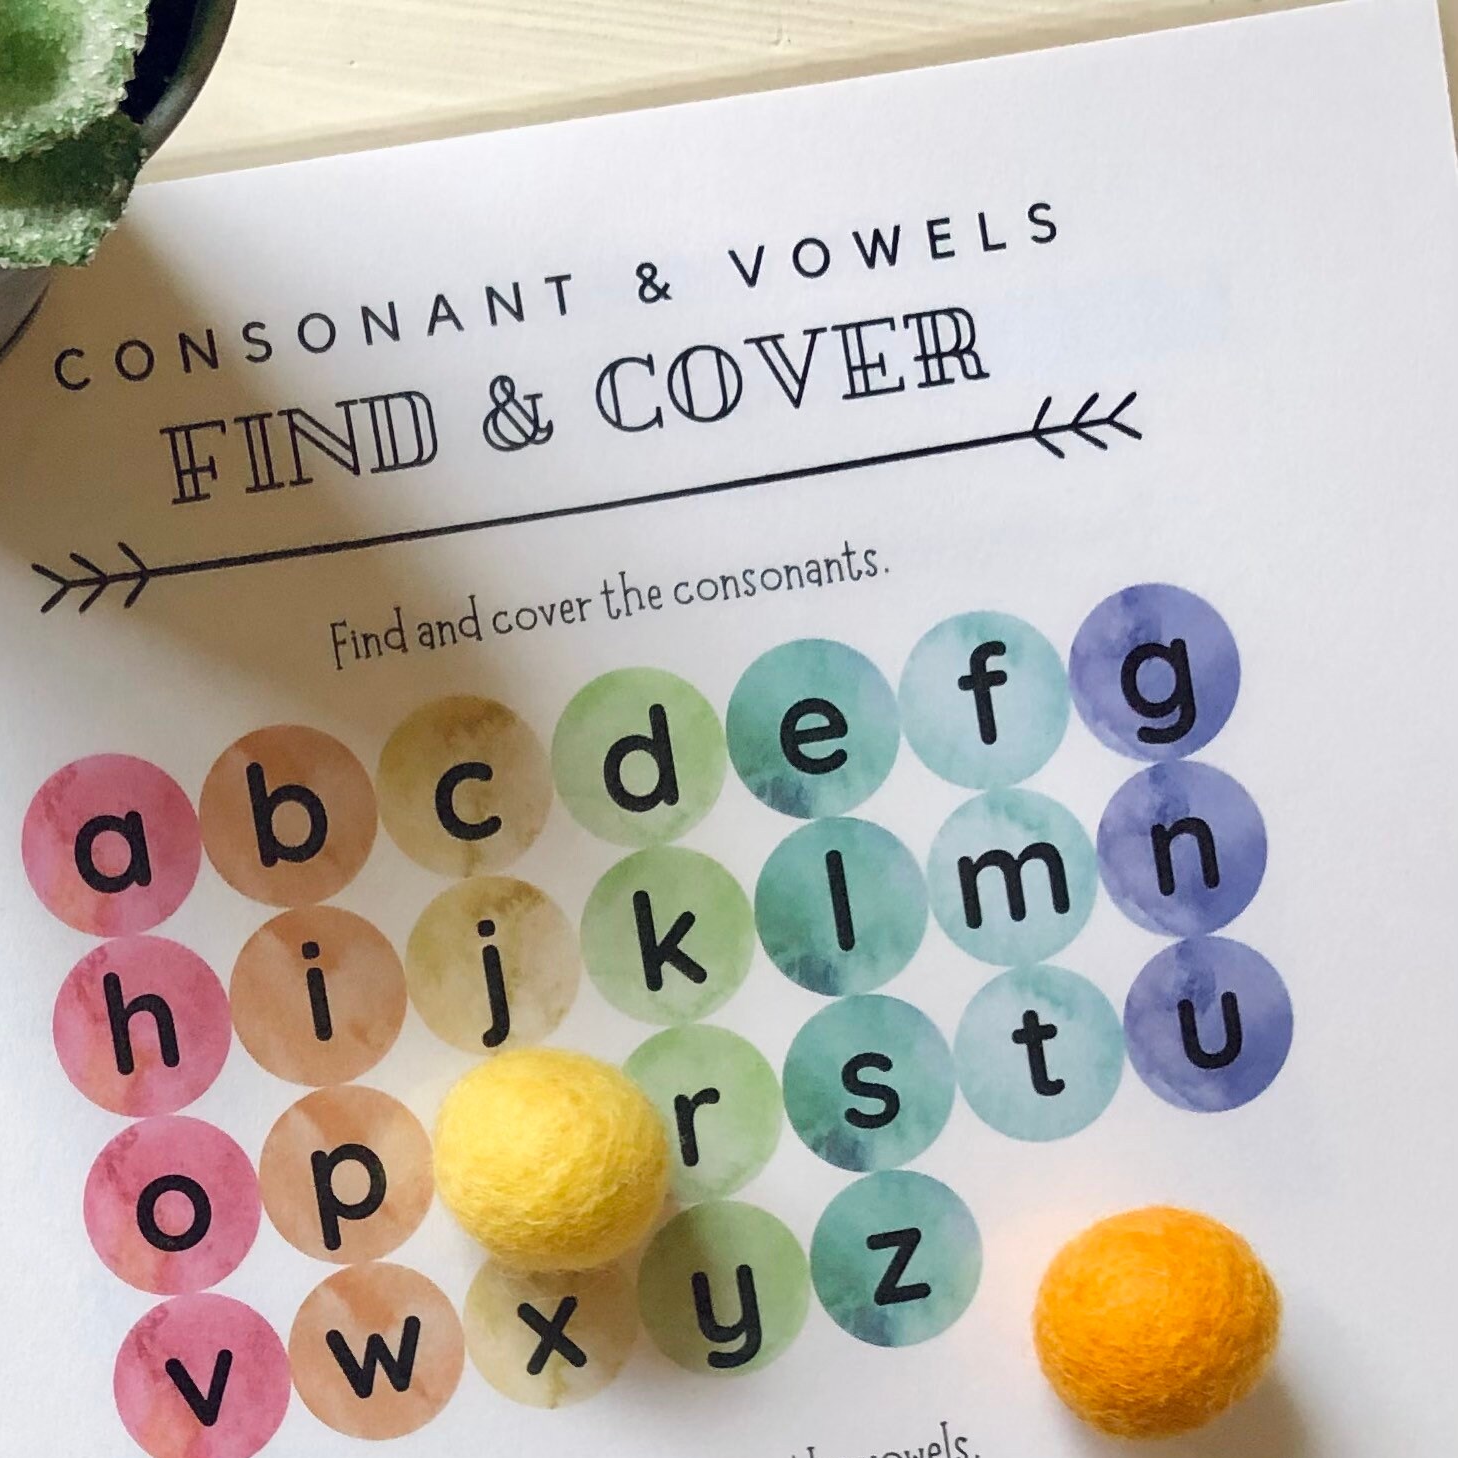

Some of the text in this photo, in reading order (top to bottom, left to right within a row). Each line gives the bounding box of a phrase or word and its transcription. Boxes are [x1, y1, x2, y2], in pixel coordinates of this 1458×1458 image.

[54, 202, 1058, 391] CONSONANT & VOWELS
[159, 306, 990, 505] FIND & COVER
[330, 540, 891, 671] Find and cover the consonants.
[75, 639, 1196, 893] a b c d e f g
[104, 973, 179, 1075] h
[302, 942, 332, 1041] i
[478, 920, 510, 1047] j
[633, 890, 707, 991] k
[958, 842, 1069, 929] m
[1151, 817, 1219, 896] n
[137, 992, 1242, 1251] o p r s t u
[166, 1228, 931, 1426] v w x y z
